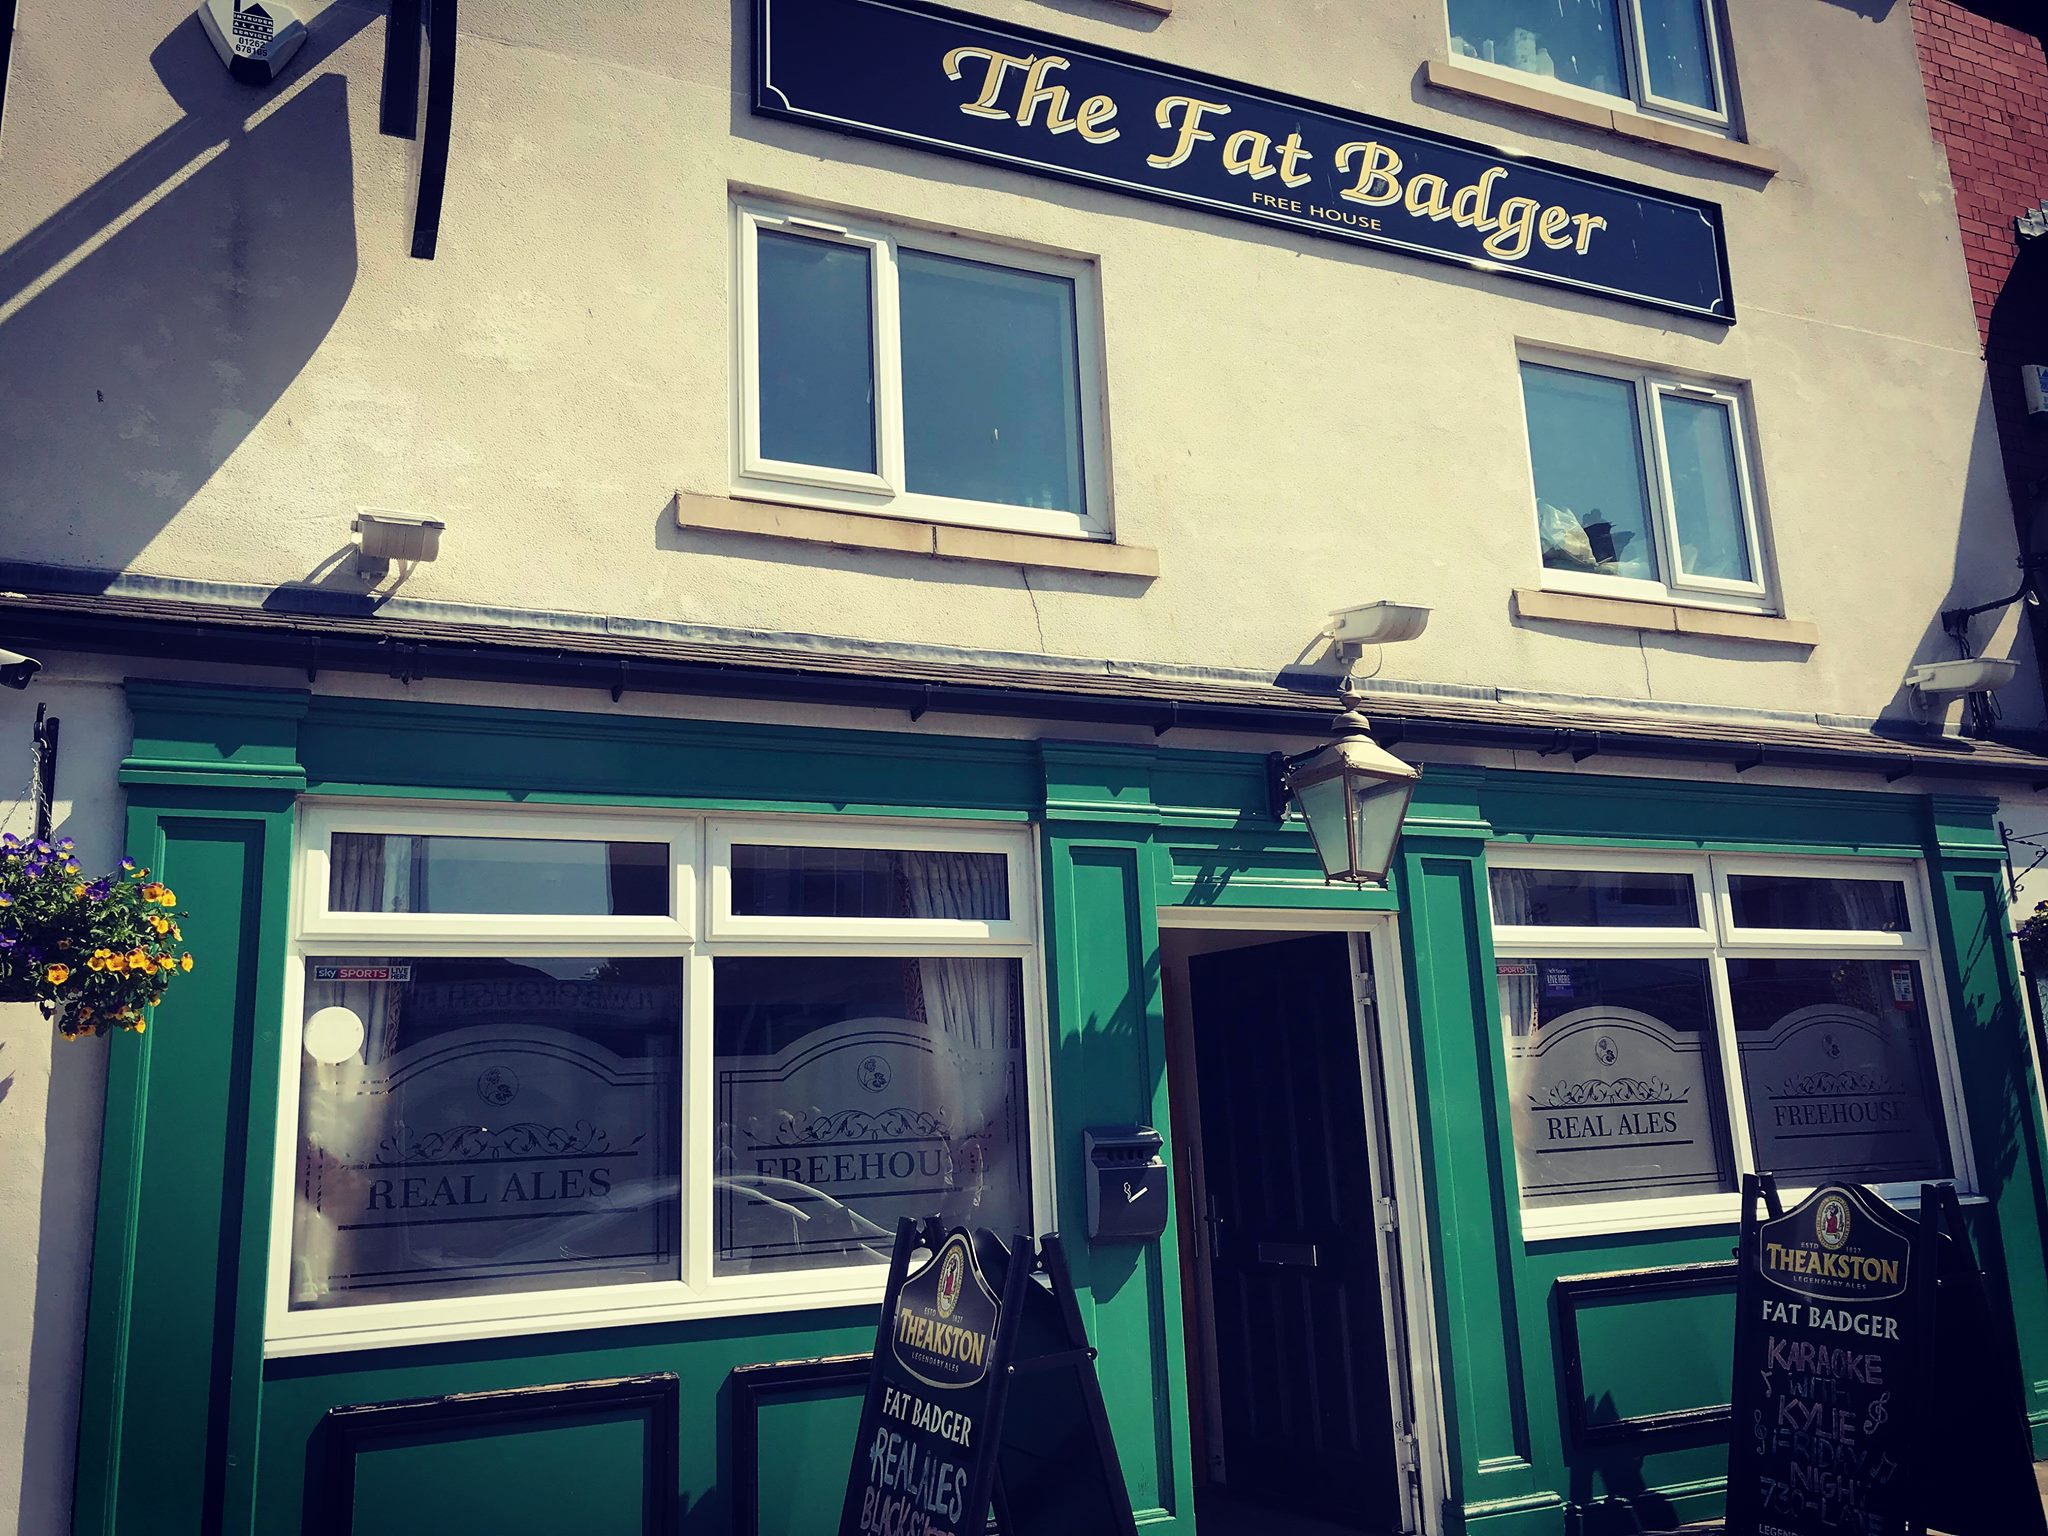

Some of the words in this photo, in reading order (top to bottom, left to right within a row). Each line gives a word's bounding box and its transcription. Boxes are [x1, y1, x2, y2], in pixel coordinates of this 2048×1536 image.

[233, 13, 273, 26] INTRUDER
[233, 21, 273, 33] ALARM
[233, 29, 273, 41] SERVICES
[238, 37, 266, 49] 01262
[942, 46, 1121, 146] The
[1146, 95, 1312, 188] Fat
[1335, 141, 1609, 261] Badger
[1252, 192, 1302, 215] FREE
[1310, 206, 1382, 232] HOUSE
[318, 968, 337, 979] sky
[340, 968, 388, 978] SPORTS
[1498, 966, 1525, 974] SPORTS
[1546, 1114, 1612, 1140] REAL
[1618, 1110, 1678, 1136] ALES
[755, 1148, 989, 1187] FREEHOU
[366, 1173, 488, 1211] REAL
[500, 1167, 612, 1202] ALES
[1766, 1242, 1900, 1285] THEAKSTON
[1793, 1275, 1844, 1289] LEGENDARY
[1844, 1281, 1867, 1291] ALES
[899, 1307, 987, 1367] THEAKSTON
[1762, 1300, 1802, 1325] FAT
[1808, 1306, 1900, 1341] BADGER
[912, 1350, 945, 1370] LEGENDARY
[944, 1360, 960, 1374] ALES
[1767, 1335, 1884, 1386] KARAOKE
[882, 1386, 912, 1422] FAT
[911, 1397, 972, 1448] BADGER
[1777, 1394, 1857, 1447] KYLIE
[870, 1427, 918, 1495] REAL
[915, 1450, 968, 1525] ALES
